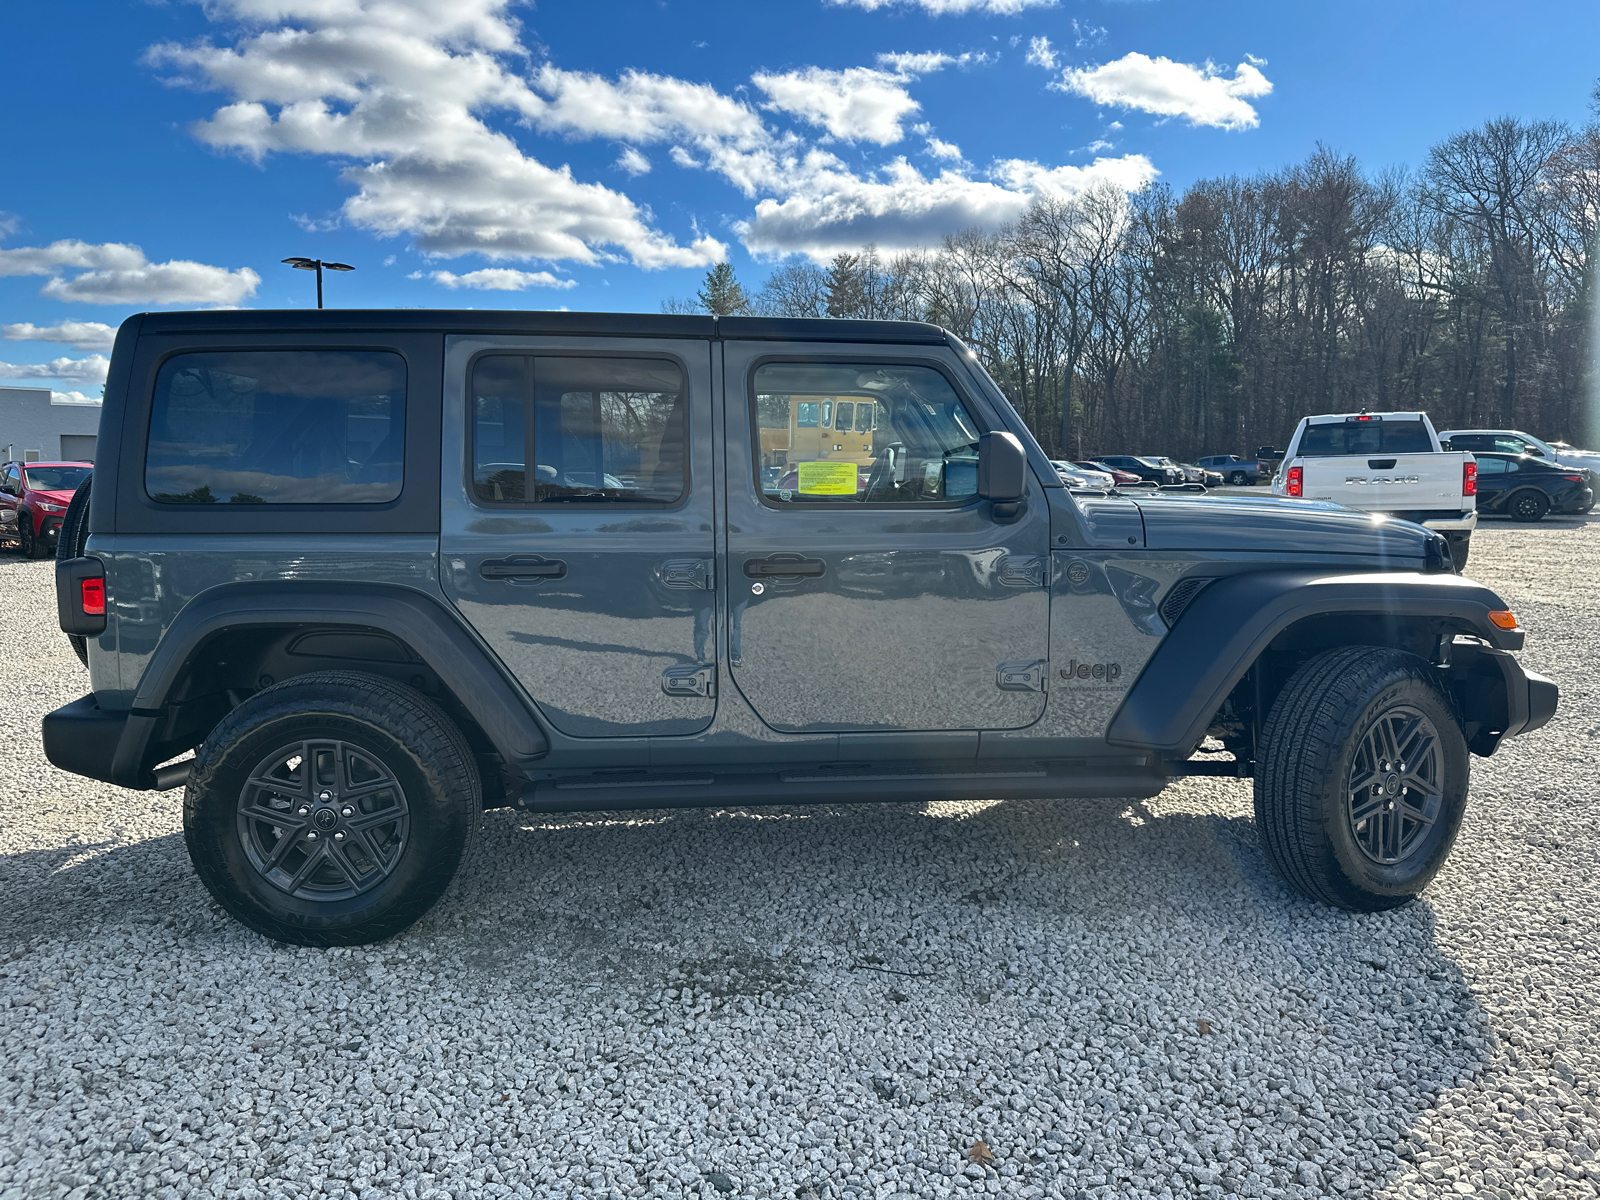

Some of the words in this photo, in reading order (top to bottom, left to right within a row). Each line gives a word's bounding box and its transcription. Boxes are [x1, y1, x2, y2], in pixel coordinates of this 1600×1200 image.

[1345, 475, 1419, 486] RAM
[1060, 659, 1122, 683] Jeep
[285, 901, 384, 928] NEXEN
